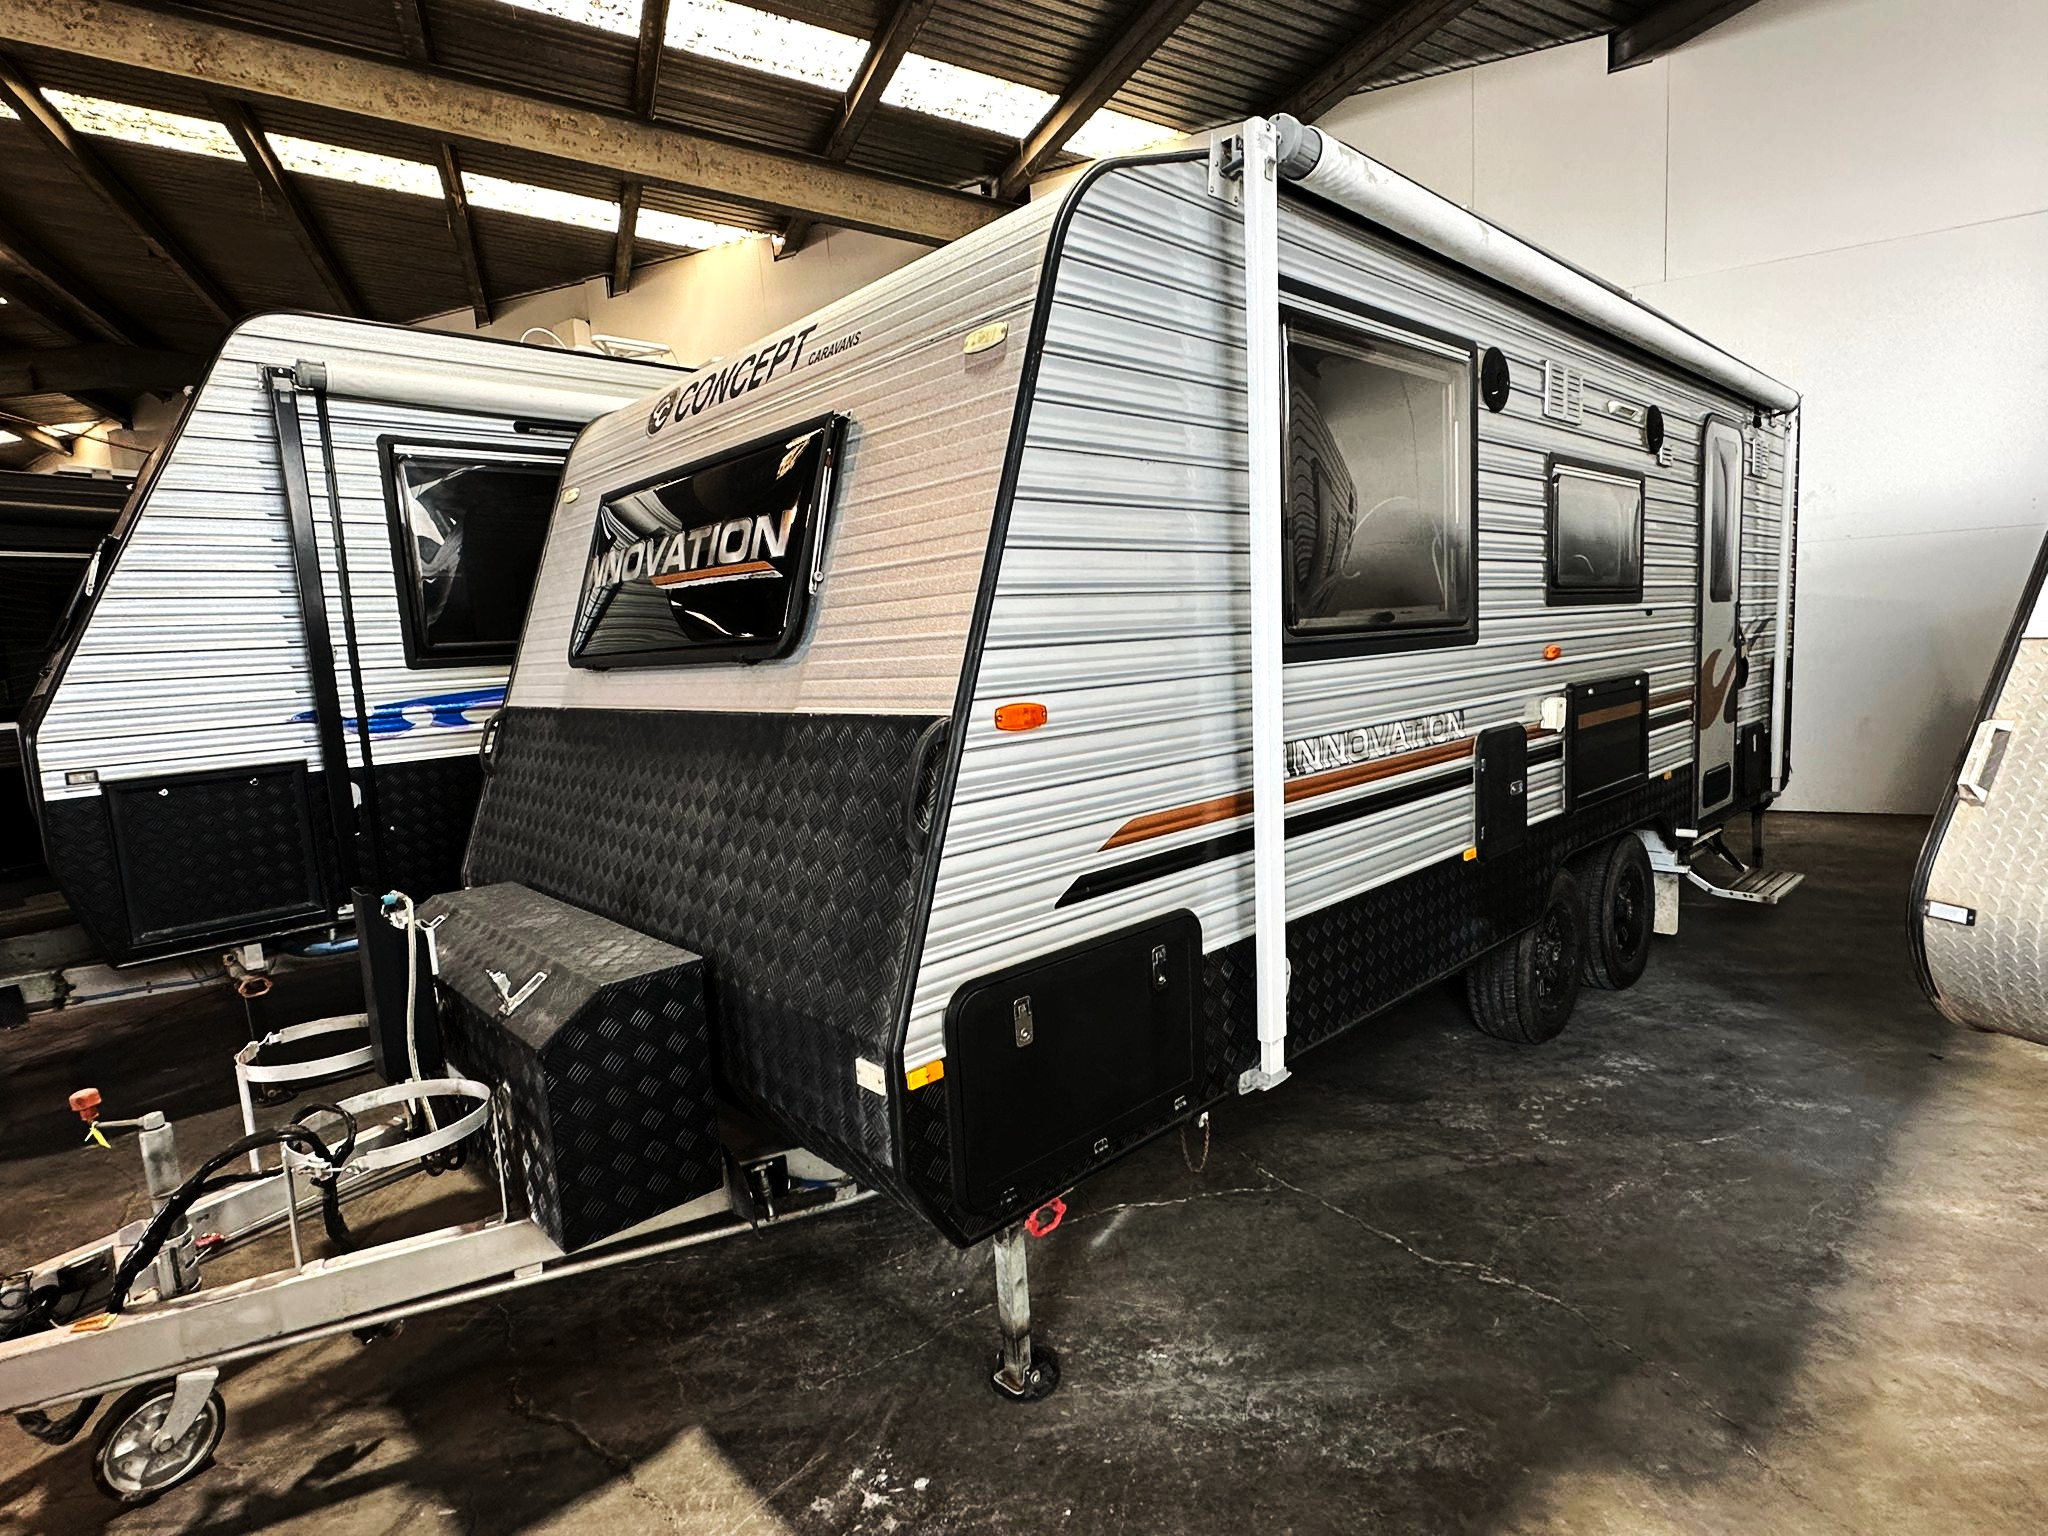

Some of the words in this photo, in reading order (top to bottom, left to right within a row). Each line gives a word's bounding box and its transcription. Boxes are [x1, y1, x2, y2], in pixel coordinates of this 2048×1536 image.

[675, 323, 818, 422] CONCEPT
[808, 331, 862, 365] CARAVANS
[587, 507, 797, 591] NNOVATION
[1284, 709, 1466, 778] INNOVATION
